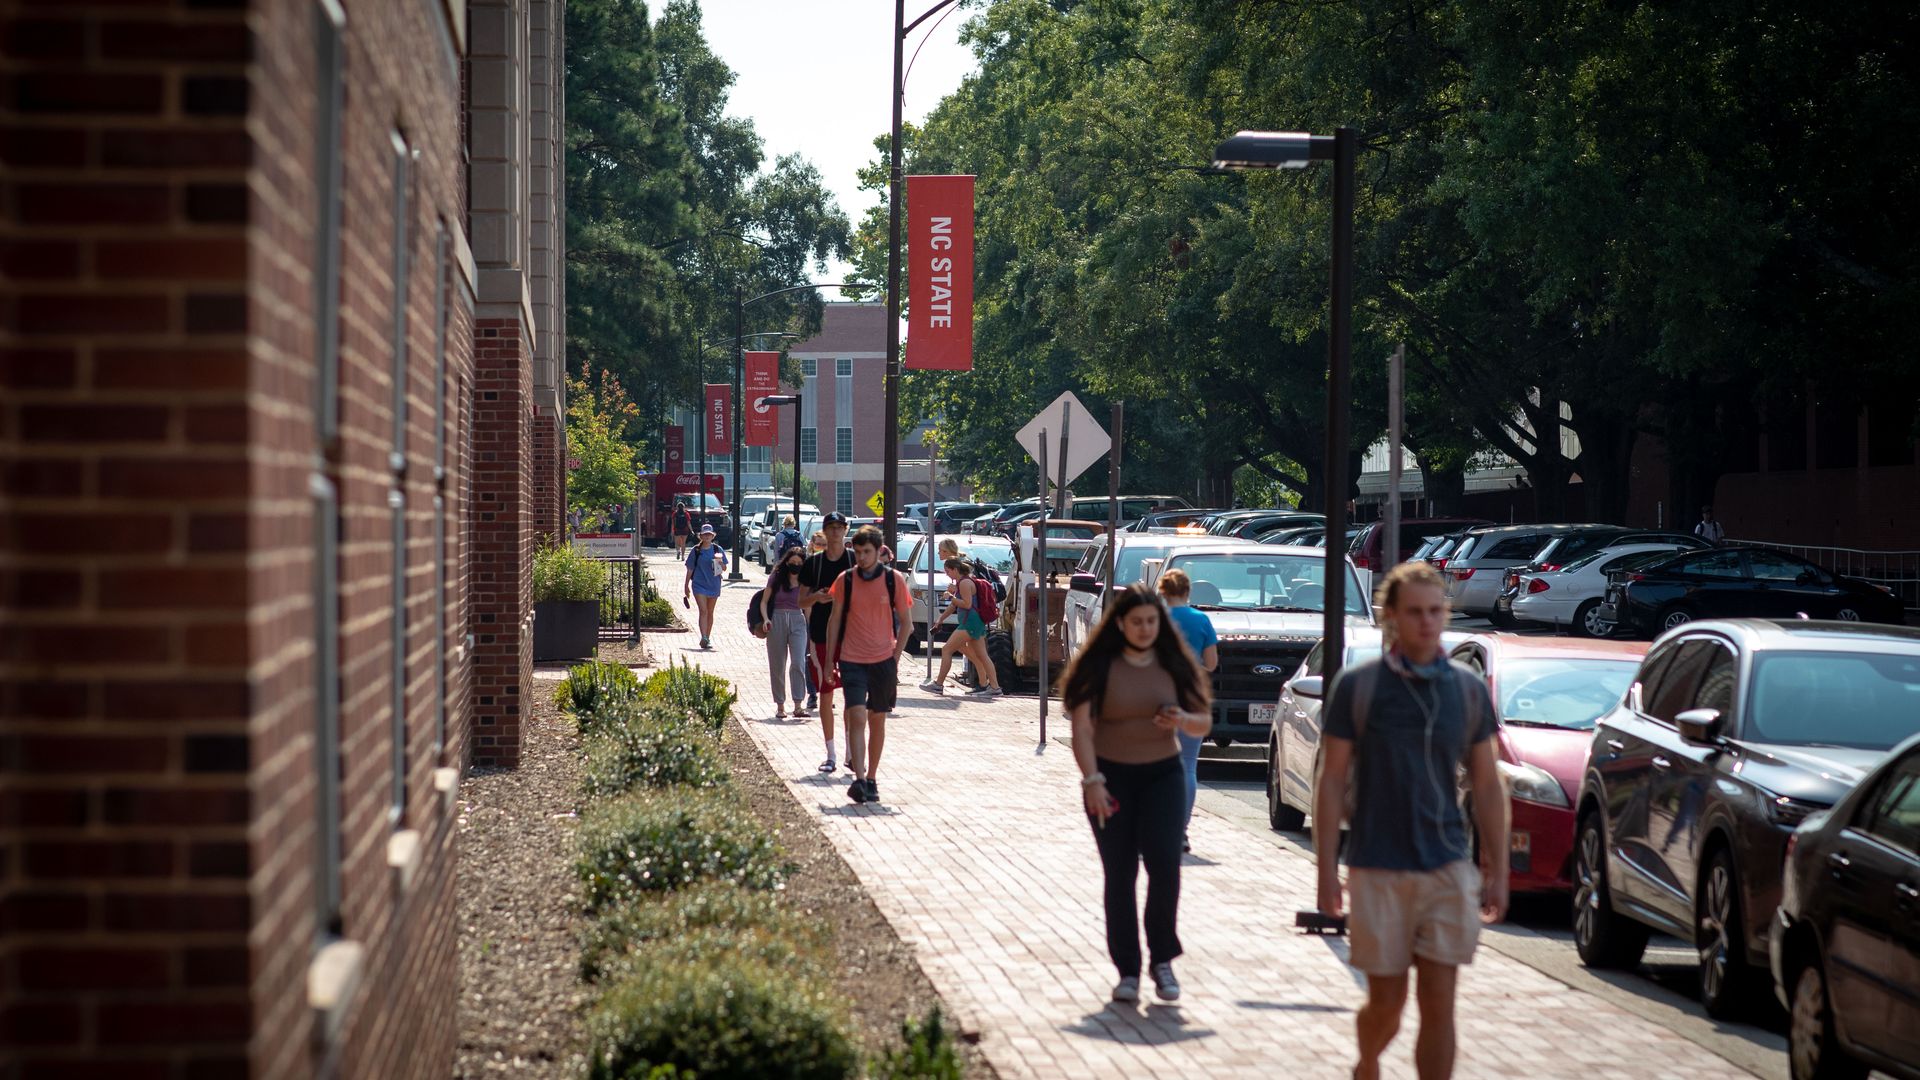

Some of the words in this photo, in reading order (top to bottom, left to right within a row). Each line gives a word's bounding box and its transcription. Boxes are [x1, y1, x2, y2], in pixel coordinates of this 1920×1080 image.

[930, 216, 952, 250] NC
[930, 257, 952, 328] STATE
[714, 399, 723, 412] NC
[714, 413, 724, 440] STATE
[1258, 665, 1275, 673] Ford
